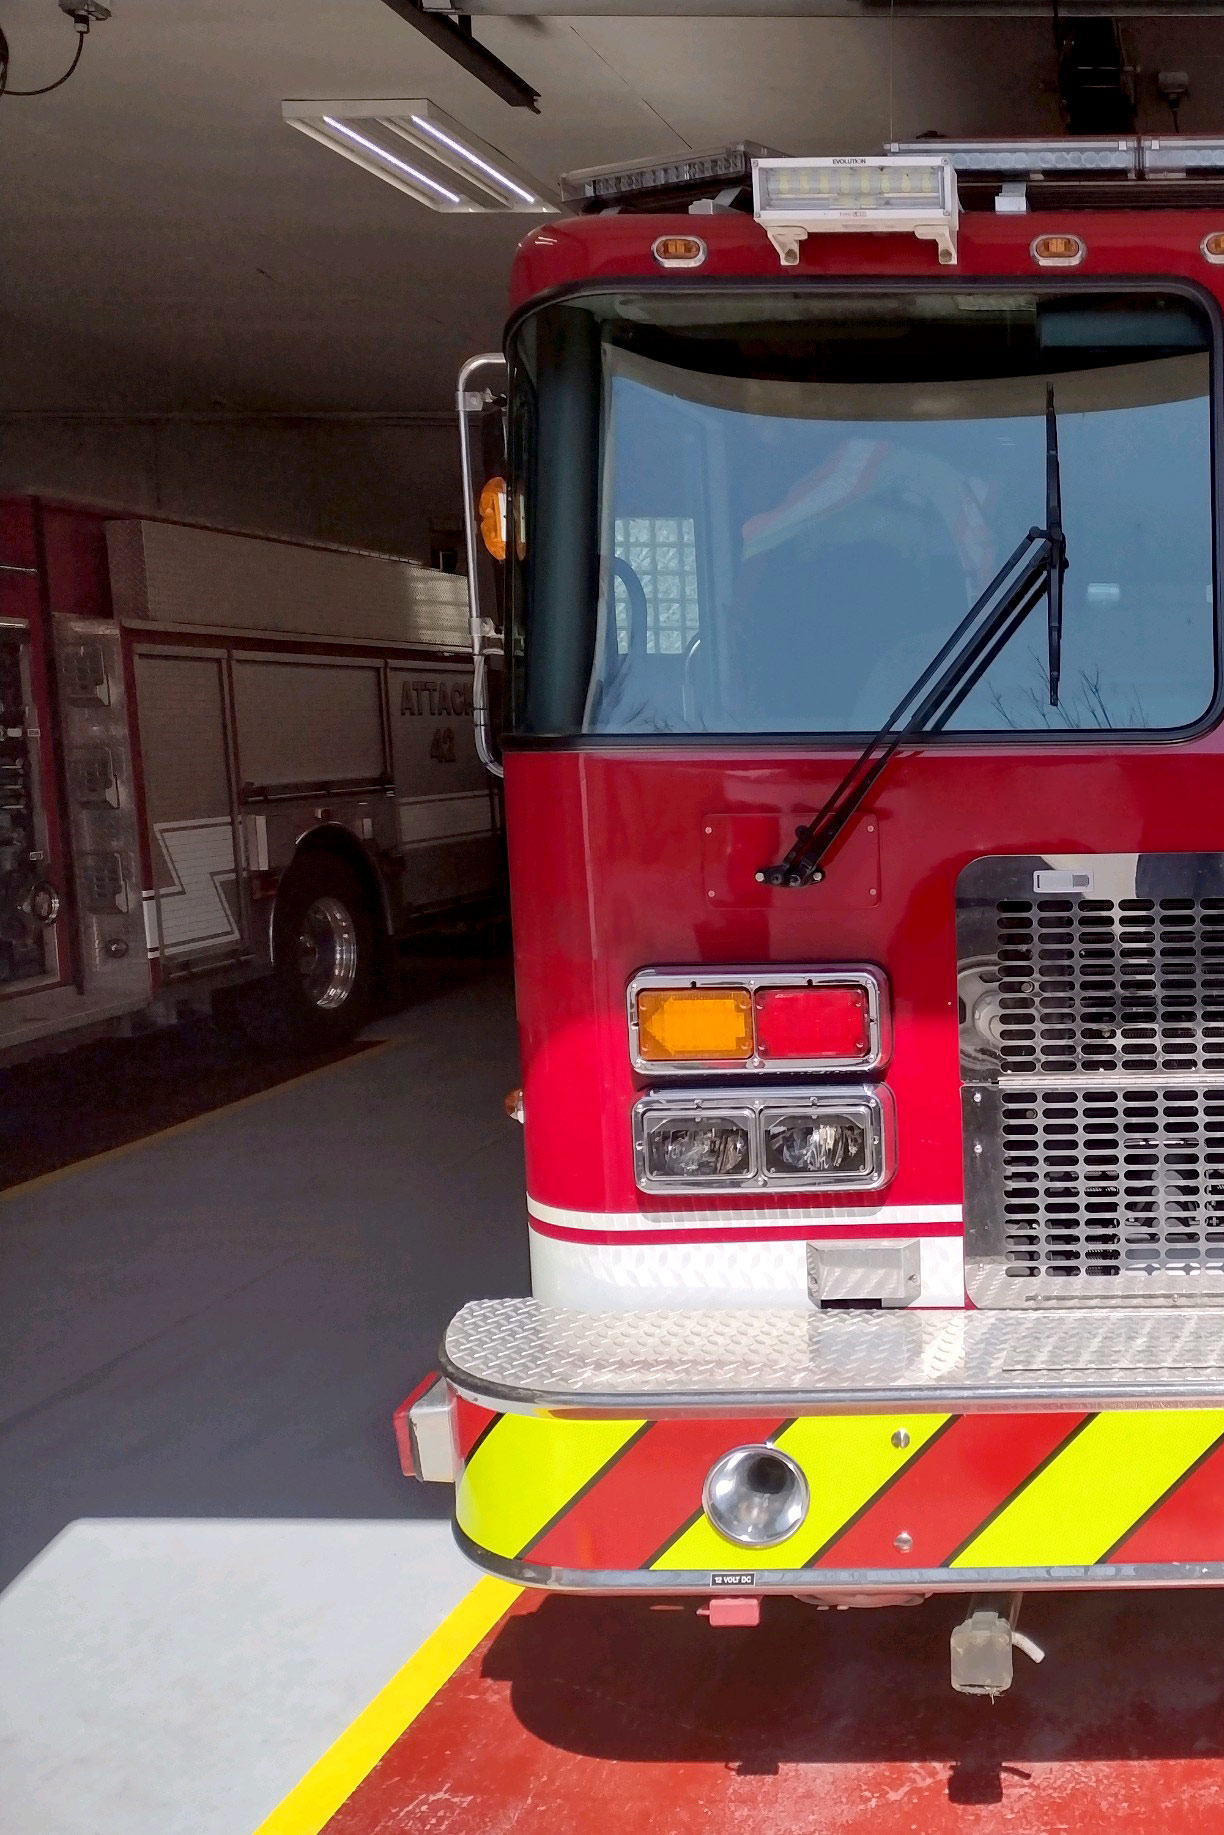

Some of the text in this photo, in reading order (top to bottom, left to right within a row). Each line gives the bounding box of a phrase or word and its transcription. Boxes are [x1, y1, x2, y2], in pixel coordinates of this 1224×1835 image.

[430, 726, 457, 764] 42
[714, 1575, 752, 1584] 12 VOLT DC
